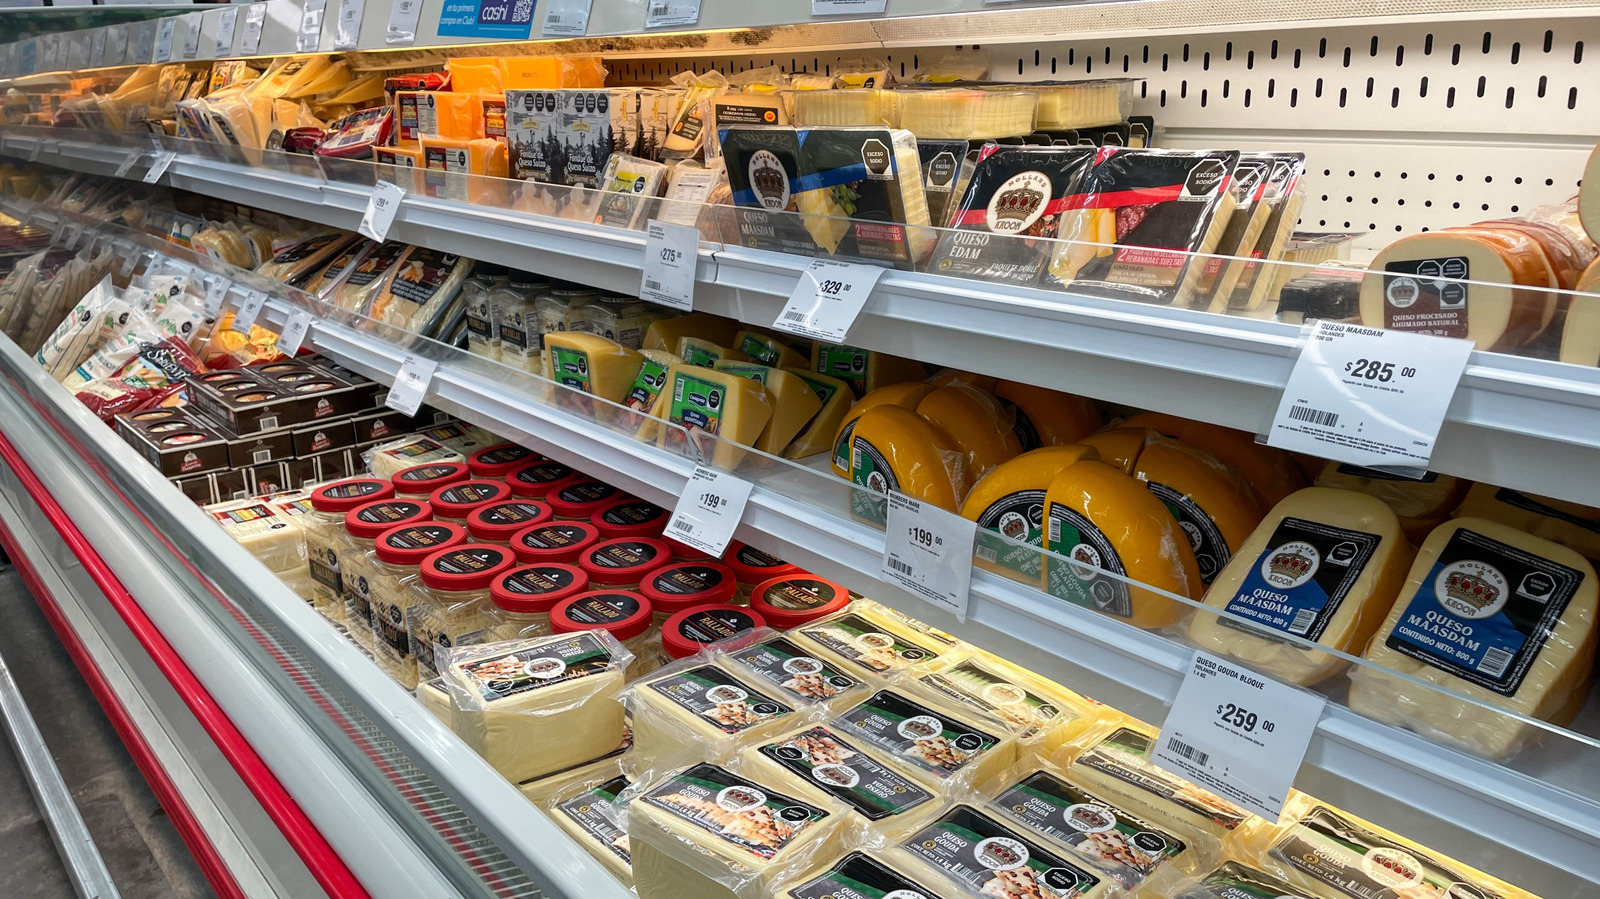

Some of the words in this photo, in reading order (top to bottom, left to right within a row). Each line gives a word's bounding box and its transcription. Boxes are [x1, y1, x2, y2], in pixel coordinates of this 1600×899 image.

[457, 5, 474, 13] primera
[482, 4, 508, 20] cashi
[440, 18, 455, 26] compra
[520, 150, 536, 158] Fondue
[536, 150, 544, 159] de
[569, 154, 586, 163] Fondue
[586, 154, 594, 164] de
[752, 152, 780, 168] HOLLAND
[518, 158, 532, 168] Queso
[567, 162, 582, 172] Queso
[1008, 174, 1048, 189] HOLLAND
[743, 212, 768, 224] QUESO
[994, 220, 1023, 231] KROON
[741, 223, 776, 238] MAASDAM
[855, 224, 862, 237] 2
[953, 231, 990, 246] QUESO
[949, 246, 982, 260] EDAM
[1117, 248, 1128, 262] 2
[1126, 255, 1158, 264] REBANADAS
[1158, 258, 1184, 266] SUELTAS
[1320, 322, 1345, 332] QUESO
[1346, 326, 1384, 338] MAASDAM
[1427, 319, 1459, 327] NATURAL
[1400, 366, 1416, 378] 00
[908, 500, 920, 509] MARK
[406, 530, 434, 546] RALLADO
[540, 529, 569, 546] RALLADO
[935, 536, 943, 546] 00
[608, 546, 640, 563] RALLADO
[1282, 544, 1316, 558] HOLLAND
[452, 553, 485, 570] RALLADO
[524, 572, 555, 590] RALLADO
[672, 571, 706, 590] RALLADO
[1056, 568, 1074, 590] PLATO
[1268, 574, 1294, 587] KROON
[1458, 562, 1503, 586] HOLLAND
[1068, 574, 1087, 600] GOUDA
[1530, 577, 1550, 588] EXCESO
[782, 586, 818, 606] RALLADO
[1252, 588, 1290, 603] QUESO
[586, 600, 620, 618] RALLADO
[1238, 594, 1294, 616] MAASDAM
[1444, 598, 1476, 617] KROON
[1229, 604, 1258, 618] CONTENIDO
[1258, 610, 1273, 622] NETO:
[1272, 616, 1283, 626] 800
[700, 616, 735, 638] RALLADO
[1425, 610, 1474, 637] QUESO
[1407, 614, 1481, 652] MAASDAM
[1398, 626, 1436, 646] CONTENIDO
[1435, 640, 1456, 656] NETO:
[1455, 650, 1470, 662] 800
[1194, 664, 1218, 678] HOLANDES
[1196, 656, 1217, 670] QUESO
[1217, 666, 1239, 680] GOUDA
[1239, 674, 1266, 690] BLOQUE
[864, 717, 887, 730] GOUDA
[870, 714, 892, 726] QUESO
[1262, 720, 1276, 733] 00
[1120, 752, 1146, 766] QUESO
[1130, 773, 1140, 781] kg
[686, 784, 711, 797] QUESO
[864, 783, 889, 799] QUESO
[873, 780, 896, 796] GOUDA
[1023, 800, 1050, 818] GOUDA
[1030, 797, 1056, 812] QUESO
[1084, 804, 1114, 820] HOLLAND
[687, 810, 694, 818] kg
[1035, 822, 1045, 832] kg
[1068, 819, 1090, 831] KROON
[934, 836, 960, 854] GOUDA
[942, 830, 968, 848] QUESO
[1142, 834, 1160, 846] EXCESO
[998, 838, 1027, 856] HOLLAND
[1319, 844, 1352, 863] QUESO
[942, 860, 952, 870] kg
[978, 856, 999, 869] KROON
[1312, 849, 1348, 869] GOUDA
[1053, 872, 1072, 884] EXCESO
[1290, 854, 1306, 866] CONT.
[1334, 876, 1346, 887] kg
[1228, 888, 1256, 899] QUES
